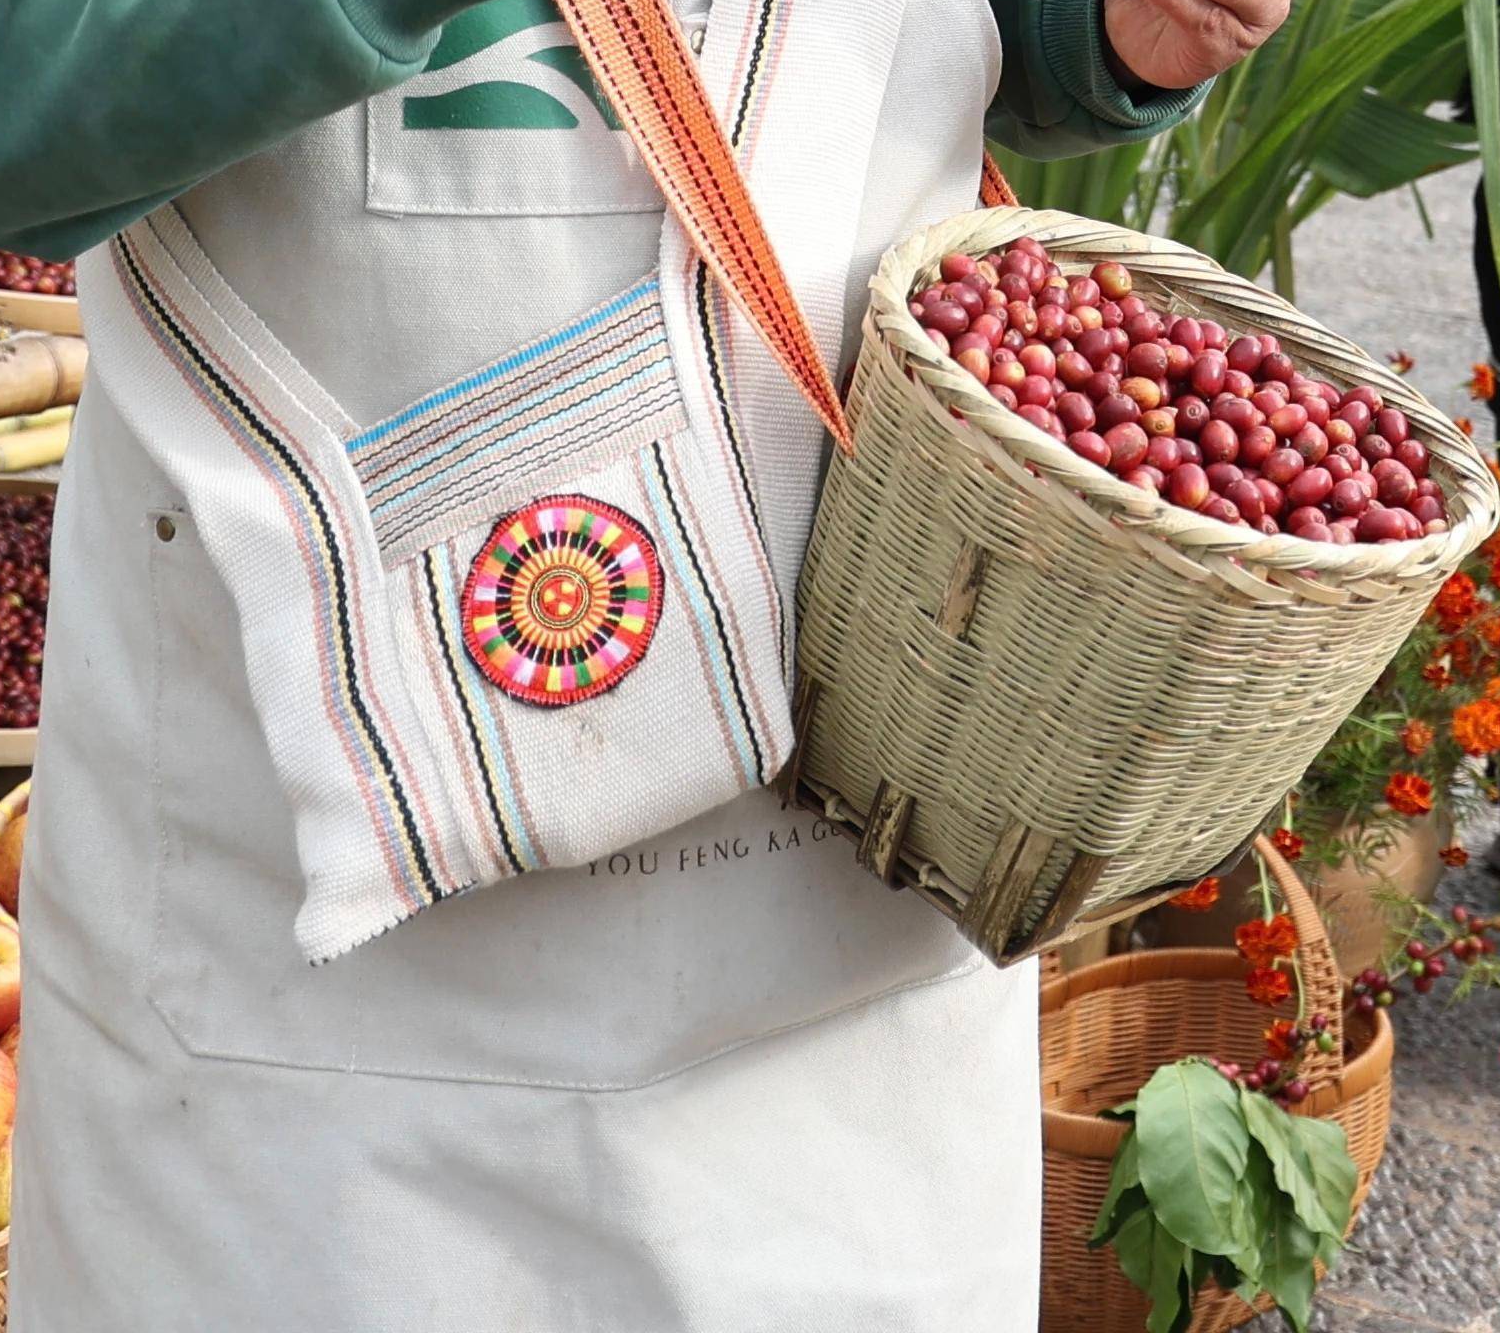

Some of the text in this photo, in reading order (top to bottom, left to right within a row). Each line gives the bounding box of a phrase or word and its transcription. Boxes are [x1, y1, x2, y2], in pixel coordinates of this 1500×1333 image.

[588, 851, 659, 877] YOU
[678, 837, 750, 872] FENG
[768, 826, 801, 852] KA
